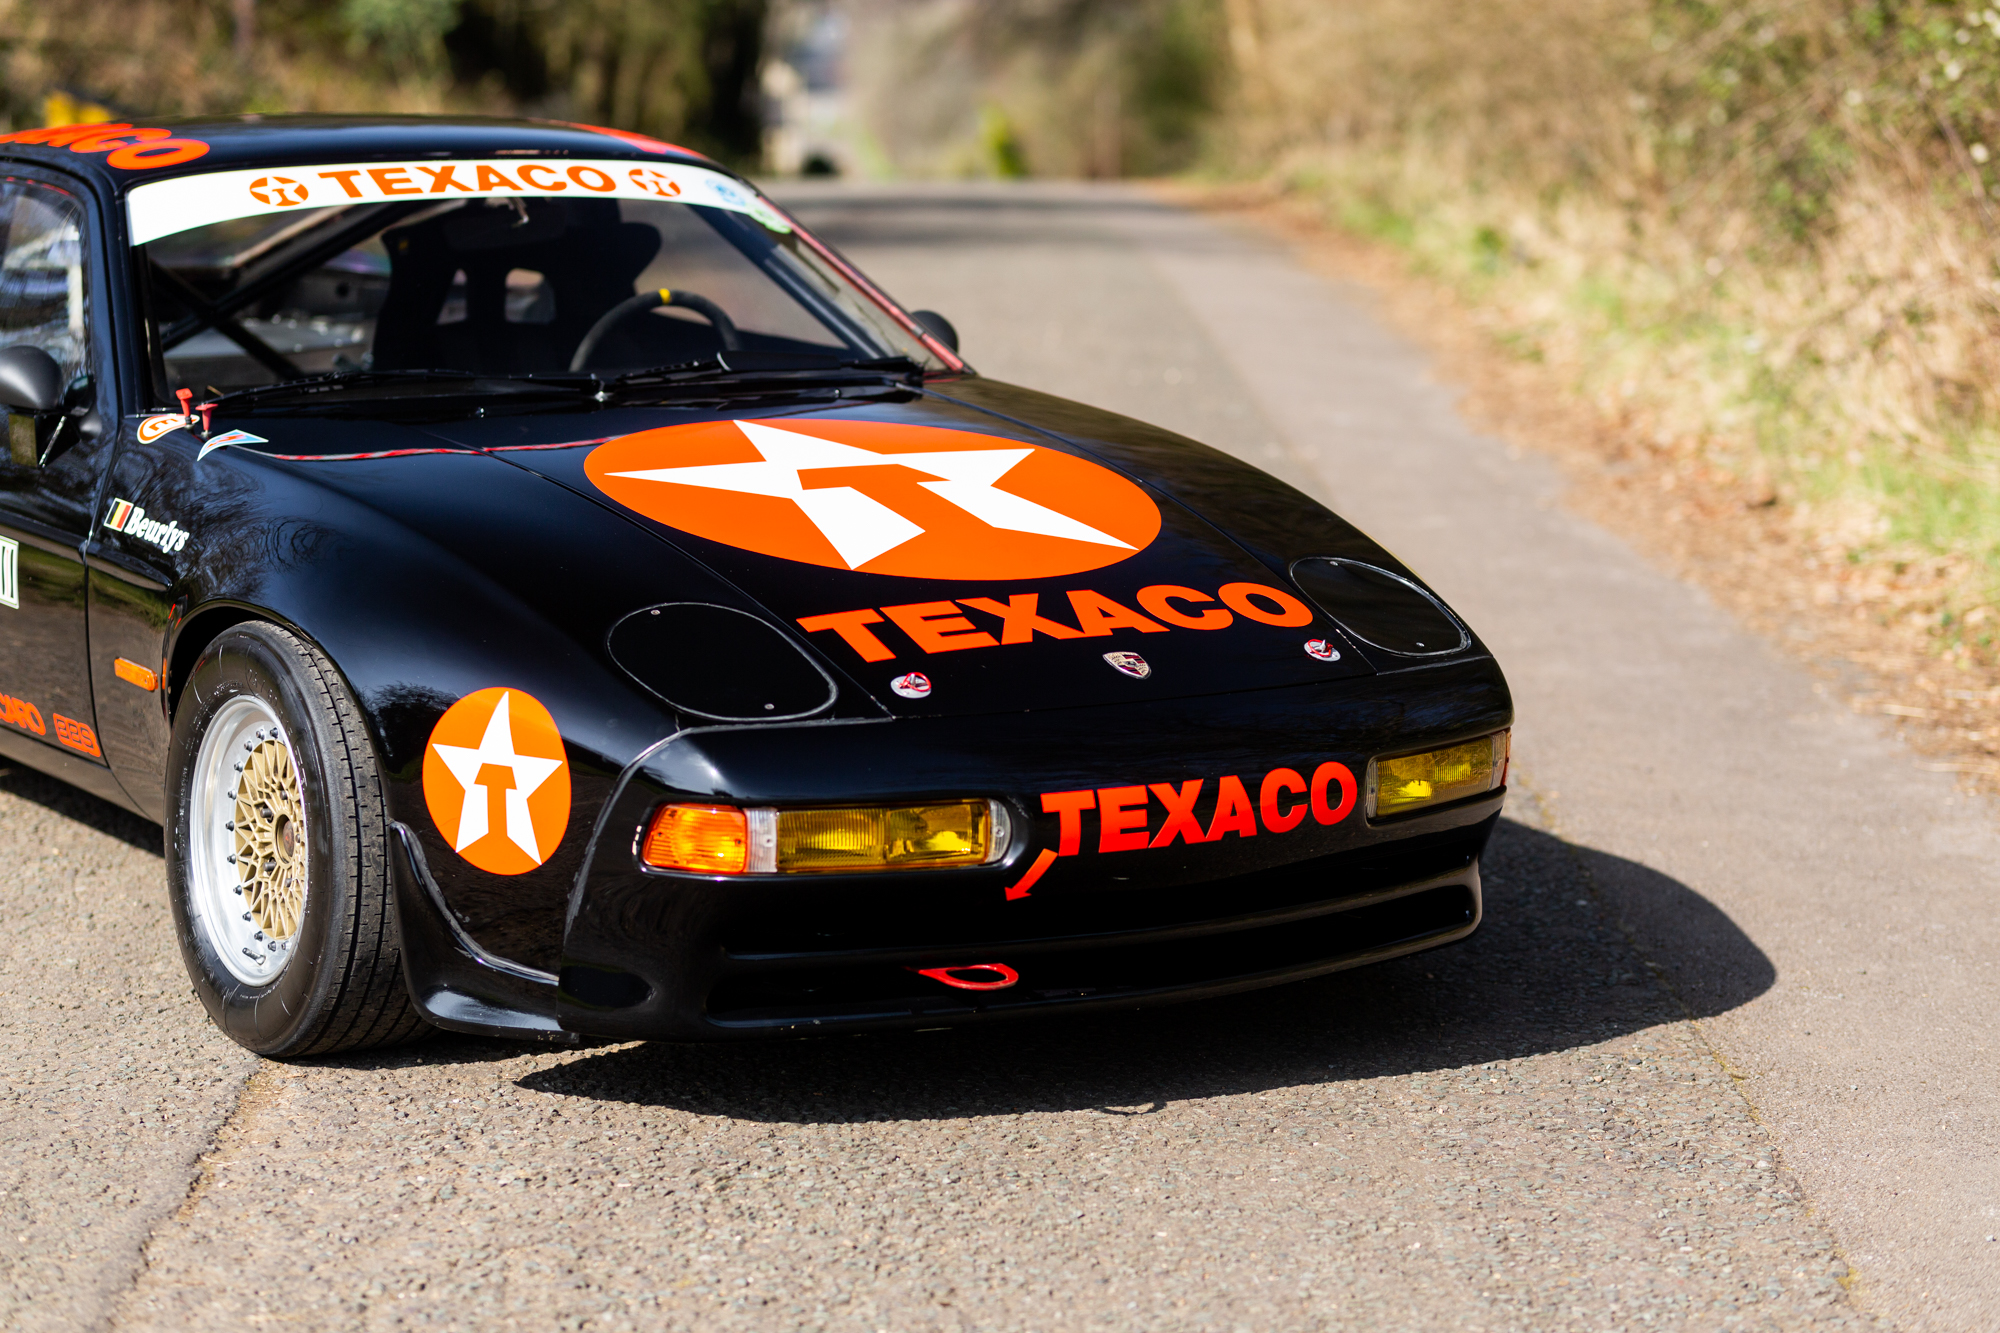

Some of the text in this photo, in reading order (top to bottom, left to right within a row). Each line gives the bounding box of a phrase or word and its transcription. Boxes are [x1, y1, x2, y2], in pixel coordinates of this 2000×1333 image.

[317, 164, 617, 199] TEXACO
[123, 506, 190, 554] Beurlys
[796, 582, 1313, 663] TEXACO
[1040, 761, 1358, 856] TEXACO
